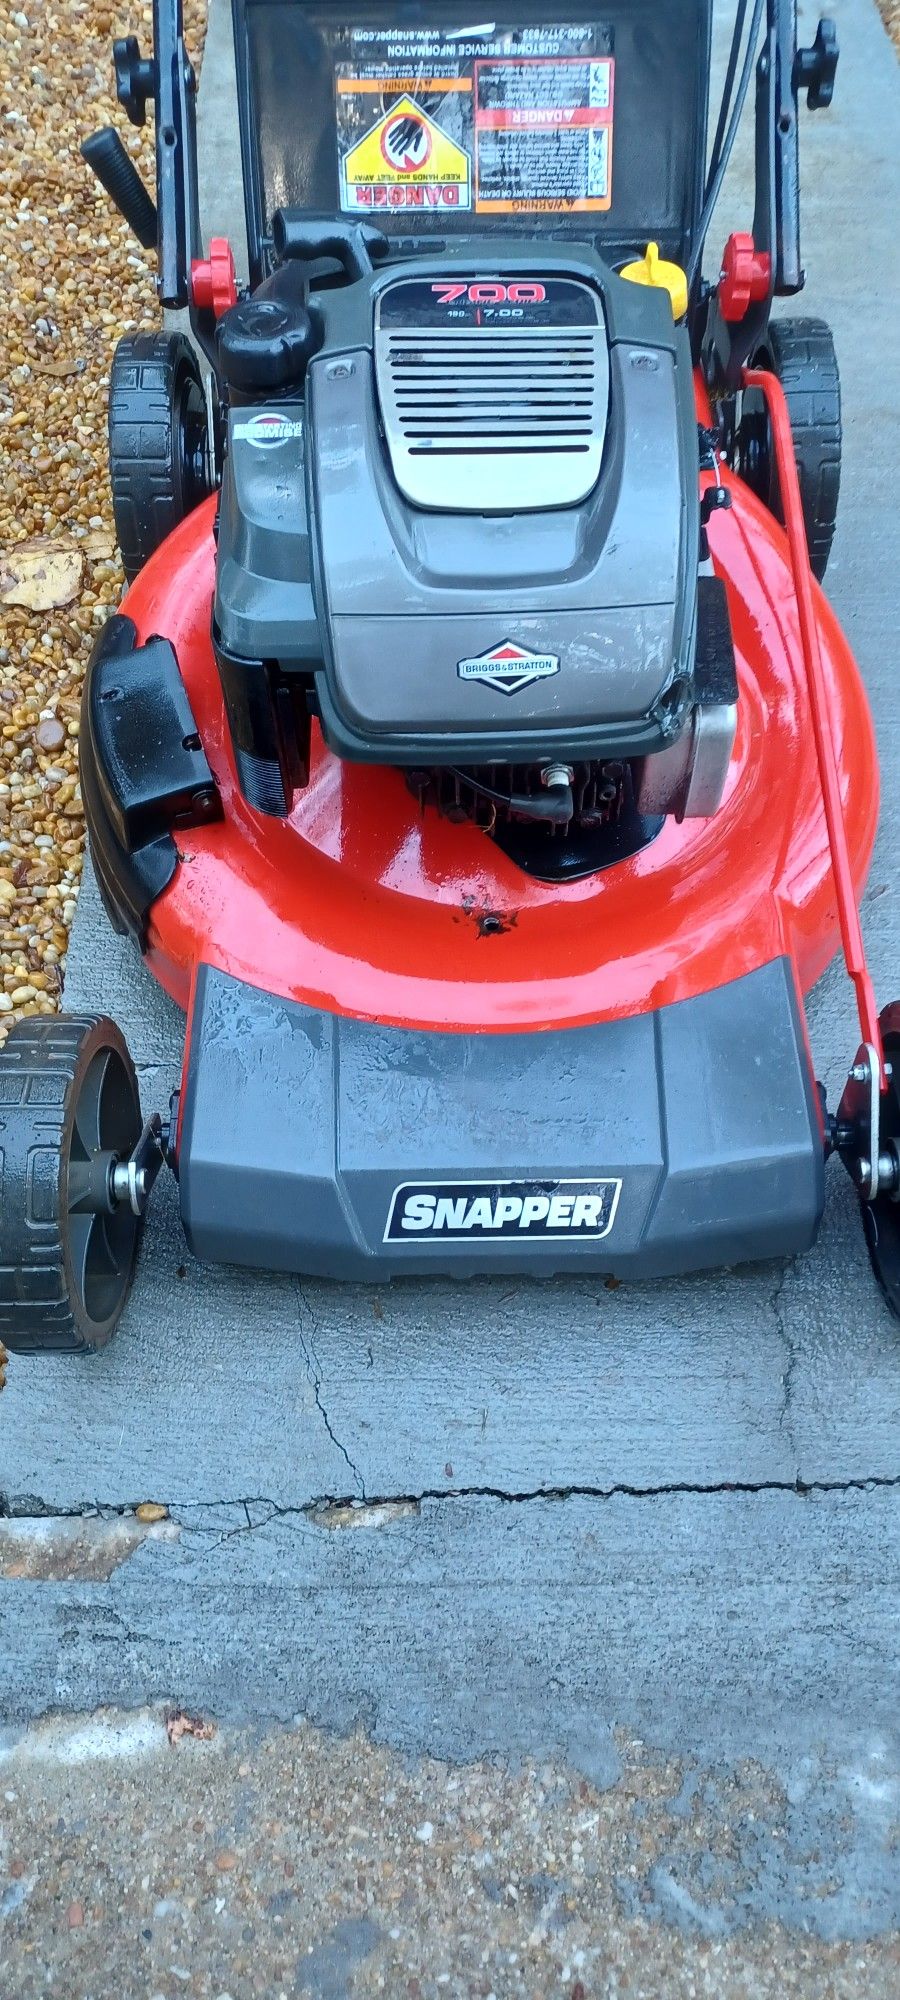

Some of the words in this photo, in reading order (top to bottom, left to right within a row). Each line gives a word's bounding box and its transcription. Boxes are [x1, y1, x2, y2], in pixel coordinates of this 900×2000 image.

[353, 28, 440, 41] www.snapper.com
[387, 44, 456, 57] INFORMATION
[458, 43, 501, 55] SERVICE
[504, 42, 560, 54] CUSTOMER
[377, 80, 422, 91] WARNING
[512, 110, 563, 123] DANGER
[441, 173, 461, 181] KEEP
[355, 184, 460, 206] DANGER
[511, 199, 564, 211] WARNING
[431, 283, 546, 303] 700
[401, 1194, 603, 1230] SNAPPER
